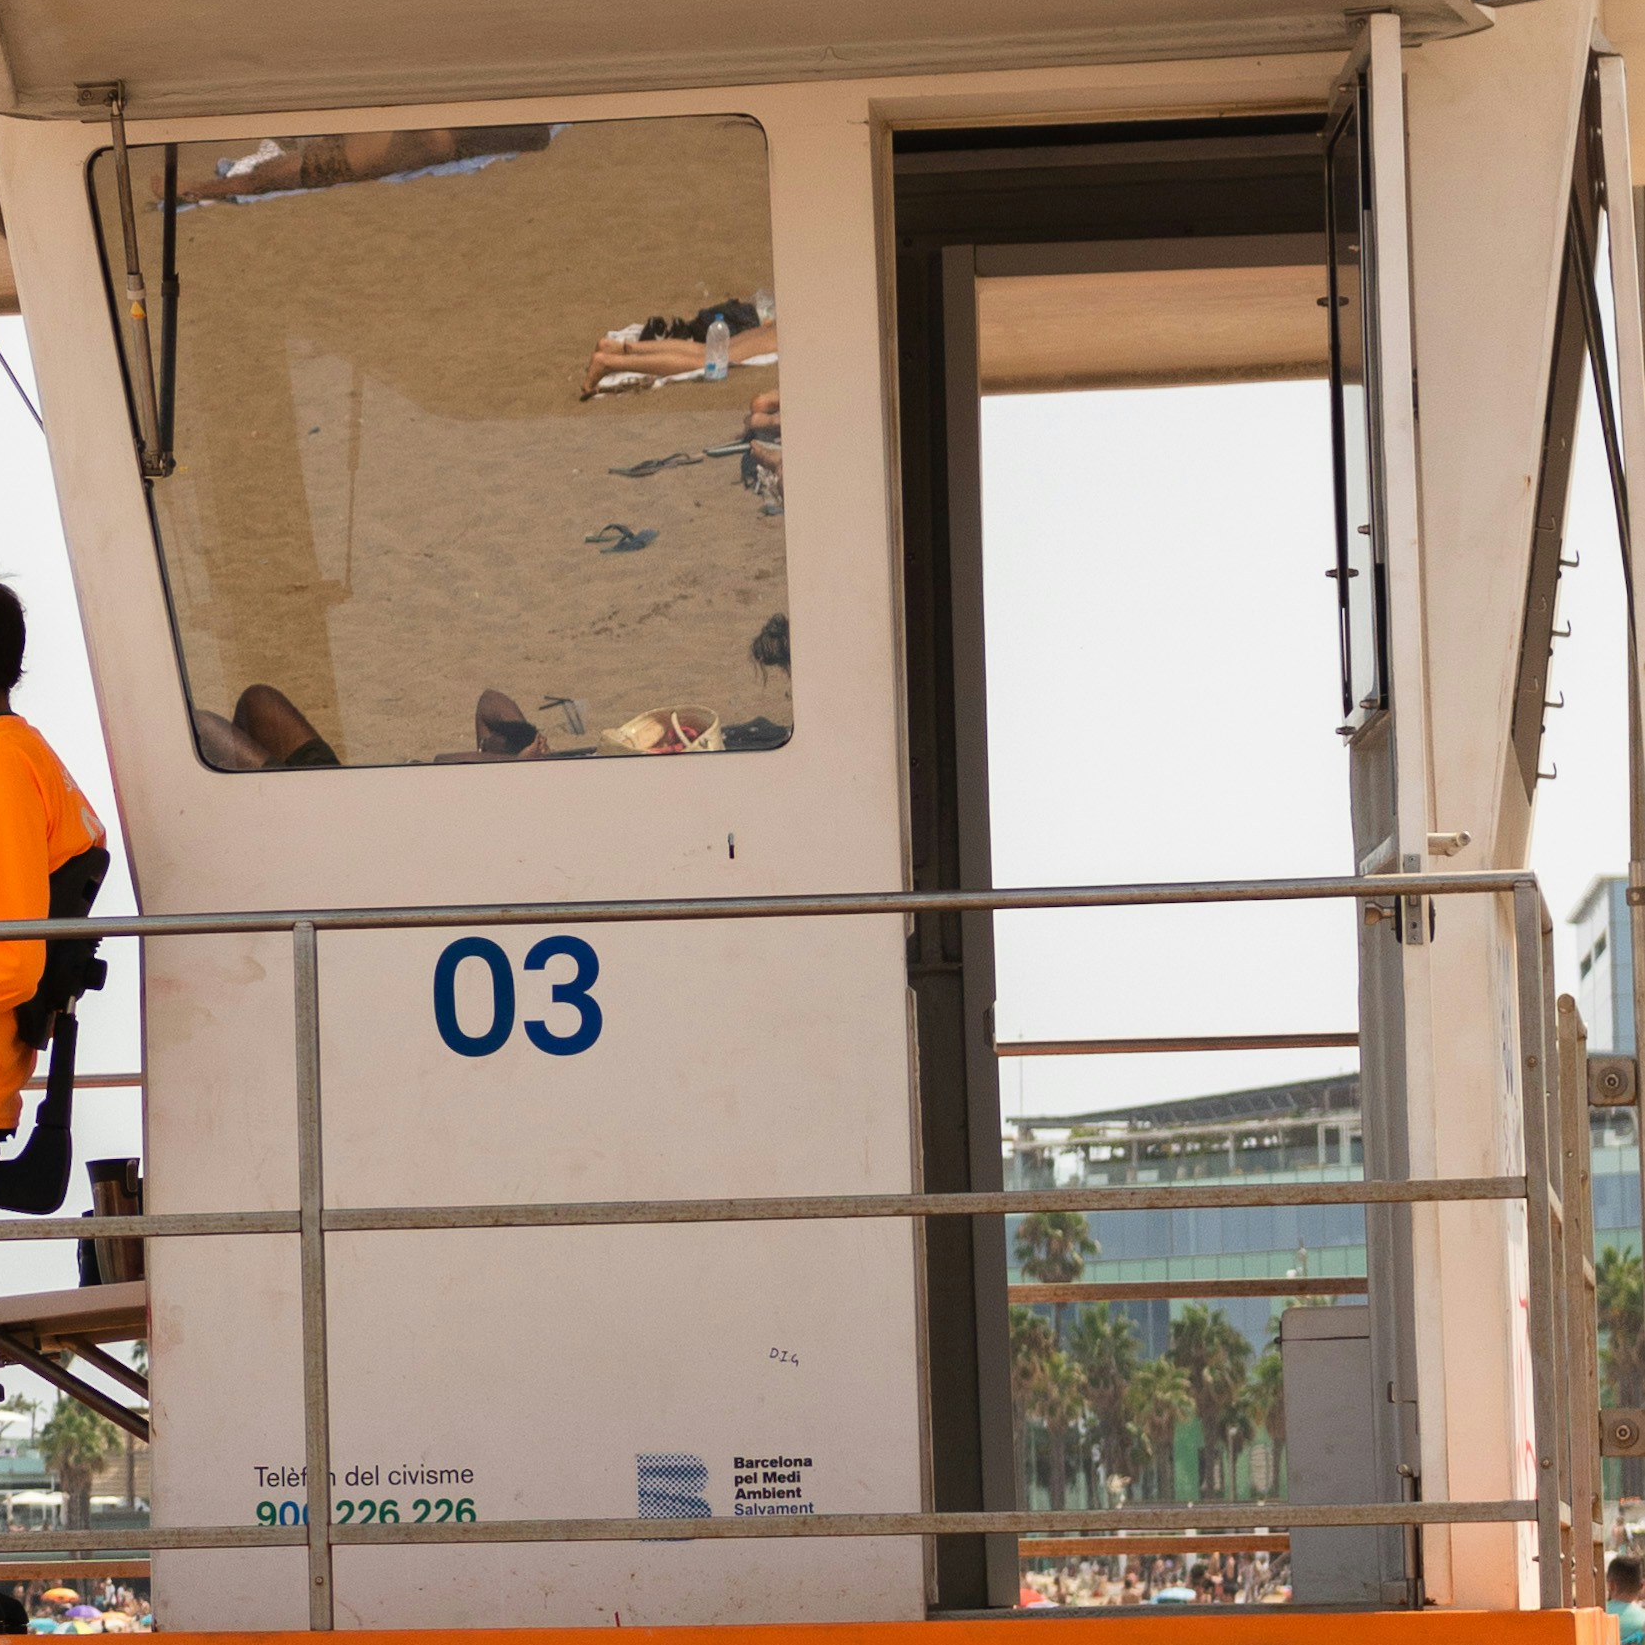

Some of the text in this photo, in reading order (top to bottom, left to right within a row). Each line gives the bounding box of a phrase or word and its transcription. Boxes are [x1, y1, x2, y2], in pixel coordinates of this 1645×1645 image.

[433, 935, 603, 1057] 03
[734, 1456, 813, 1469] Barcelona
[254, 1464, 474, 1488] Telèfn del civisme
[734, 1471, 802, 1485] pel Medi
[734, 1487, 802, 1500] Ambient
[256, 1497, 477, 1526] 90 226 226
[734, 1502, 815, 1516] Salvament
